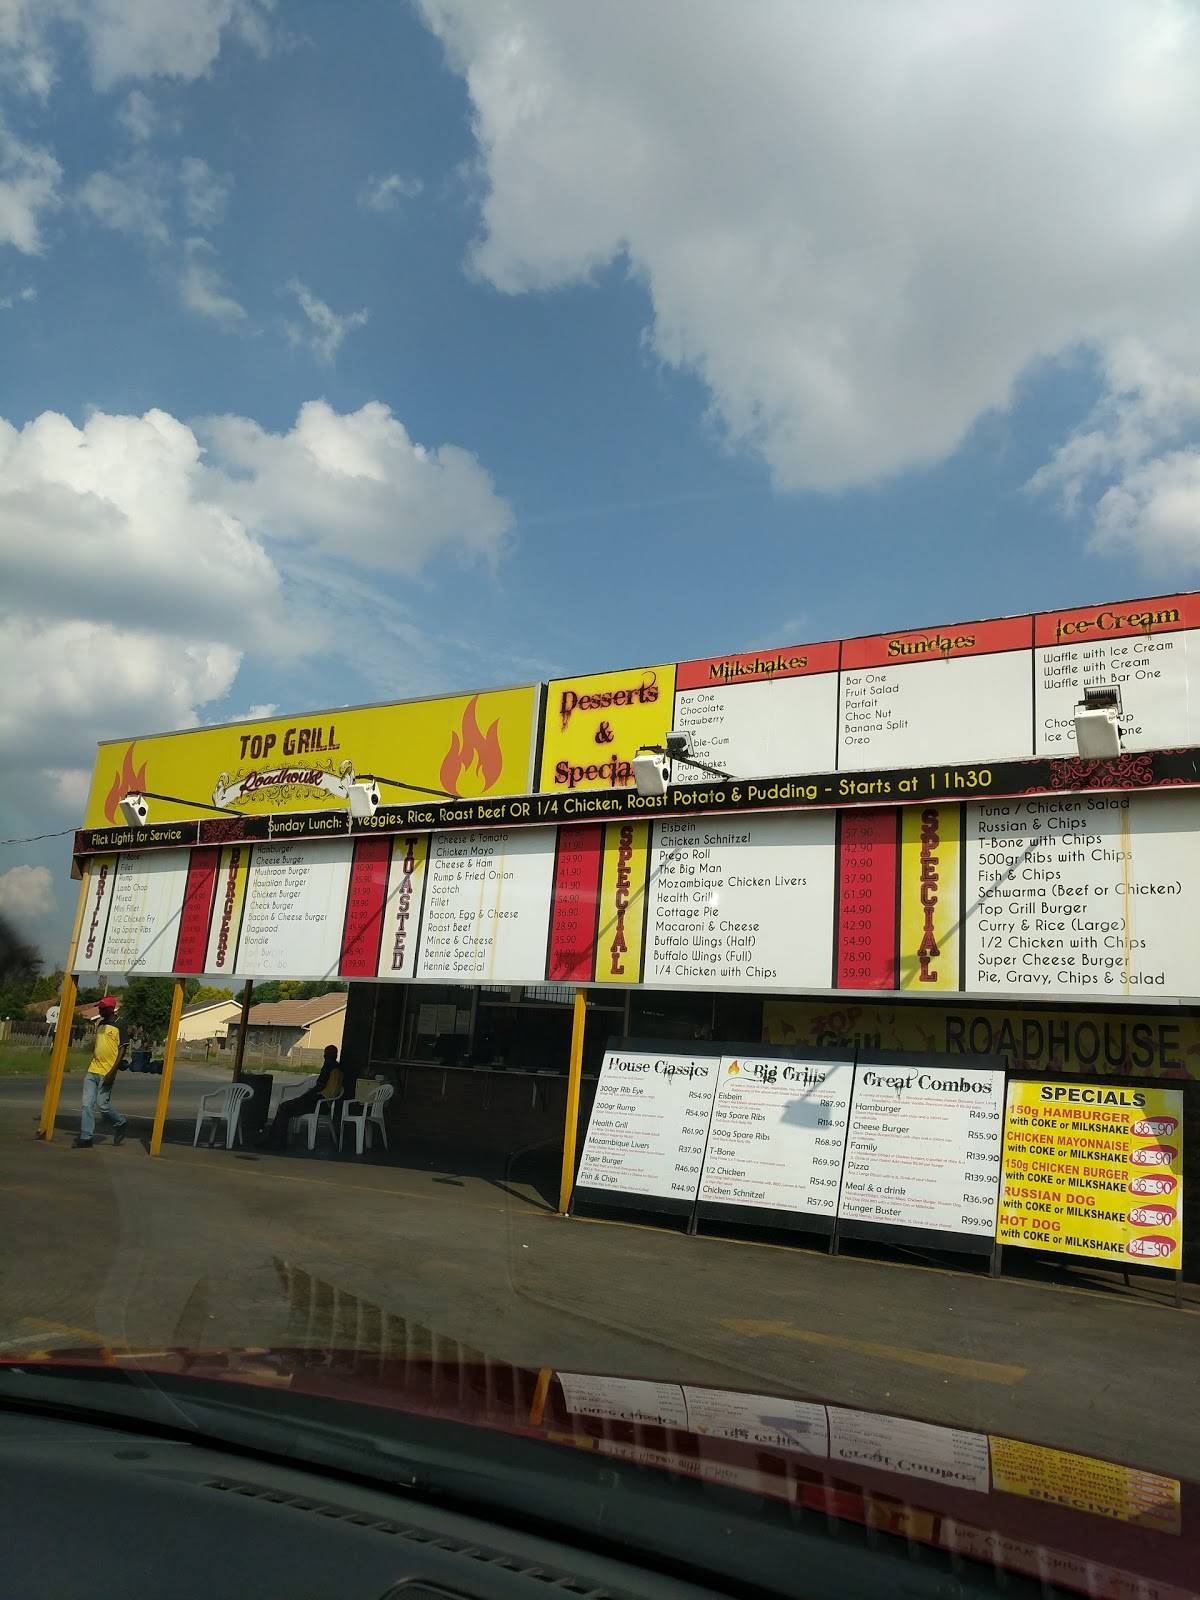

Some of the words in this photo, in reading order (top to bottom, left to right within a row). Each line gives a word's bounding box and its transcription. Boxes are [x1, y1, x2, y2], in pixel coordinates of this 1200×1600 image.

[1056, 608, 1180, 643] Ice-Cream
[888, 635, 975, 657] Sundaes
[1044, 652, 1078, 663] Waffle
[1084, 649, 1105, 659] with
[1111, 647, 1128, 656] Ice
[1134, 642, 1173, 653] Cream
[710, 655, 808, 682] Milkshakes
[1044, 665, 1078, 676] Waffle
[1084, 662, 1105, 672] with
[1111, 658, 1149, 669] Cream
[846, 677, 861, 685] Bar
[866, 675, 886, 683] One
[1044, 677, 1078, 689] Waffle
[1084, 675, 1106, 685] with
[1111, 672, 1130, 682] Bar
[1136, 670, 1161, 679] One
[560, 671, 659, 715] Desserts
[846, 688, 866, 697] Fruit
[870, 684, 899, 694] Salad
[680, 704, 724, 715] Chocolate
[846, 699, 877, 709] Parfait
[680, 716, 724, 726] Strawberry
[846, 712, 871, 721] Choc
[876, 710, 891, 718] Nut
[595, 721, 614, 744] &
[845, 724, 882, 733] Banana
[887, 720, 908, 730] Split
[240, 733, 276, 760] TOP
[284, 726, 340, 756] GRILL
[845, 736, 870, 744] Oreo
[240, 768, 323, 795] Roadhouse
[268, 819, 305, 833] Sunday
[309, 816, 342, 829] Lunch:
[408, 810, 435, 823] Rice,
[440, 808, 474, 821] Roast
[478, 805, 505, 819] Beef
[510, 803, 531, 817] OR
[537, 800, 558, 815] 1/4
[564, 798, 622, 812] Chicken,
[628, 794, 668, 808] Roast
[674, 789, 725, 805] Potato
[731, 787, 742, 801] &
[749, 783, 818, 801] Pudding
[839, 779, 891, 796] Starts
[898, 778, 918, 792] at
[979, 820, 1027, 832] Russian
[1033, 819, 1041, 830] &
[1047, 817, 1087, 830] Chips
[92, 833, 110, 845] Flick
[111, 830, 135, 845] Lights
[137, 830, 148, 841] for
[150, 830, 182, 840] Service
[661, 834, 700, 848] Chicken
[704, 833, 751, 844] Schnitzel
[979, 837, 1023, 848] T-Bone
[1030, 836, 1056, 847] with
[1062, 834, 1102, 847] Chips
[282, 856, 304, 864] Burger
[659, 851, 688, 860] Prego
[692, 849, 710, 859] Roll
[845, 857, 873, 868] 79.90
[255, 868, 287, 876] Mushroom
[289, 867, 310, 875] Burger
[435, 860, 464, 869] Cheese
[659, 865, 675, 874] The
[680, 864, 695, 875] Big
[700, 864, 722, 873] Man
[658, 878, 724, 889] Mozambique
[728, 877, 770, 888] Chicken
[775, 876, 807, 886] Livers
[845, 873, 872, 884] 37.90
[978, 870, 1002, 881] Fish
[1007, 870, 1016, 880] &
[1022, 869, 1061, 882] Chips
[610, 825, 633, 974] SPECIAL
[917, 808, 940, 982] SPECIAL
[85, 864, 108, 958] GRILLS
[392, 838, 417, 970] TOASTED
[978, 903, 1002, 916] Top
[1009, 902, 1036, 914] Grill
[1041, 902, 1087, 915] Burger
[428, 924, 450, 932] Roast
[453, 922, 472, 931] Beef
[655, 936, 689, 946] Buffalo
[692, 936, 722, 947] Wings
[726, 936, 756, 947] (Half)
[425, 949, 452, 958] Bennie
[454, 949, 485, 959] Special
[843, 951, 871, 961] 78.90
[978, 954, 1017, 966] Super
[1023, 954, 1075, 966] Cheese
[1082, 954, 1129, 968] Burger
[945, 1016, 1181, 1068] ROADHOUSE
[608, 1058, 650, 1072] House
[743, 1061, 777, 1084] Big
[863, 1068, 918, 1093] Great
[918, 1075, 992, 1093] Combos
[1041, 1086, 1146, 1107] SPECIALS
[596, 1102, 615, 1110] 200gr
[686, 1109, 708, 1117] R54.90
[855, 1103, 901, 1113] Hamburger
[970, 1111, 999, 1119] R49.90
[1010, 1105, 1039, 1117] 150g
[1043, 1107, 1130, 1123] HAMBURGER
[682, 1127, 704, 1136] R61.90
[1007, 1132, 1054, 1144] CHICKEN
[1057, 1136, 1129, 1151] MAYONNAISE
[710, 1147, 735, 1156] T-Bone
[812, 1157, 839, 1166] R69.90
[850, 1142, 878, 1152] Family
[967, 1152, 999, 1162] R139.90
[585, 1155, 600, 1163] Tiger
[602, 1156, 623, 1165] Burger
[675, 1164, 699, 1173] R46.90
[1005, 1159, 1029, 1171] 150g
[1032, 1162, 1080, 1175] CHICKEN
[1084, 1165, 1128, 1180] BURGER
[703, 1186, 731, 1195] Chicken
[733, 1189, 765, 1199] Schnitzel
[807, 1198, 834, 1207] R57.90
[1005, 1186, 1061, 1202] RUSSIAN
[1066, 1193, 1095, 1206] DOG
[843, 1203, 874, 1214] Hunger
[875, 1206, 901, 1216] Buster
[962, 1216, 993, 1227] R99.90
[1003, 1200, 1022, 1209] with
[1025, 1202, 1051, 1213] COKE
[1066, 1207, 1125, 1222] MILKSHAKE
[1000, 1214, 1028, 1226] HOT
[1032, 1219, 1061, 1231] DOG
